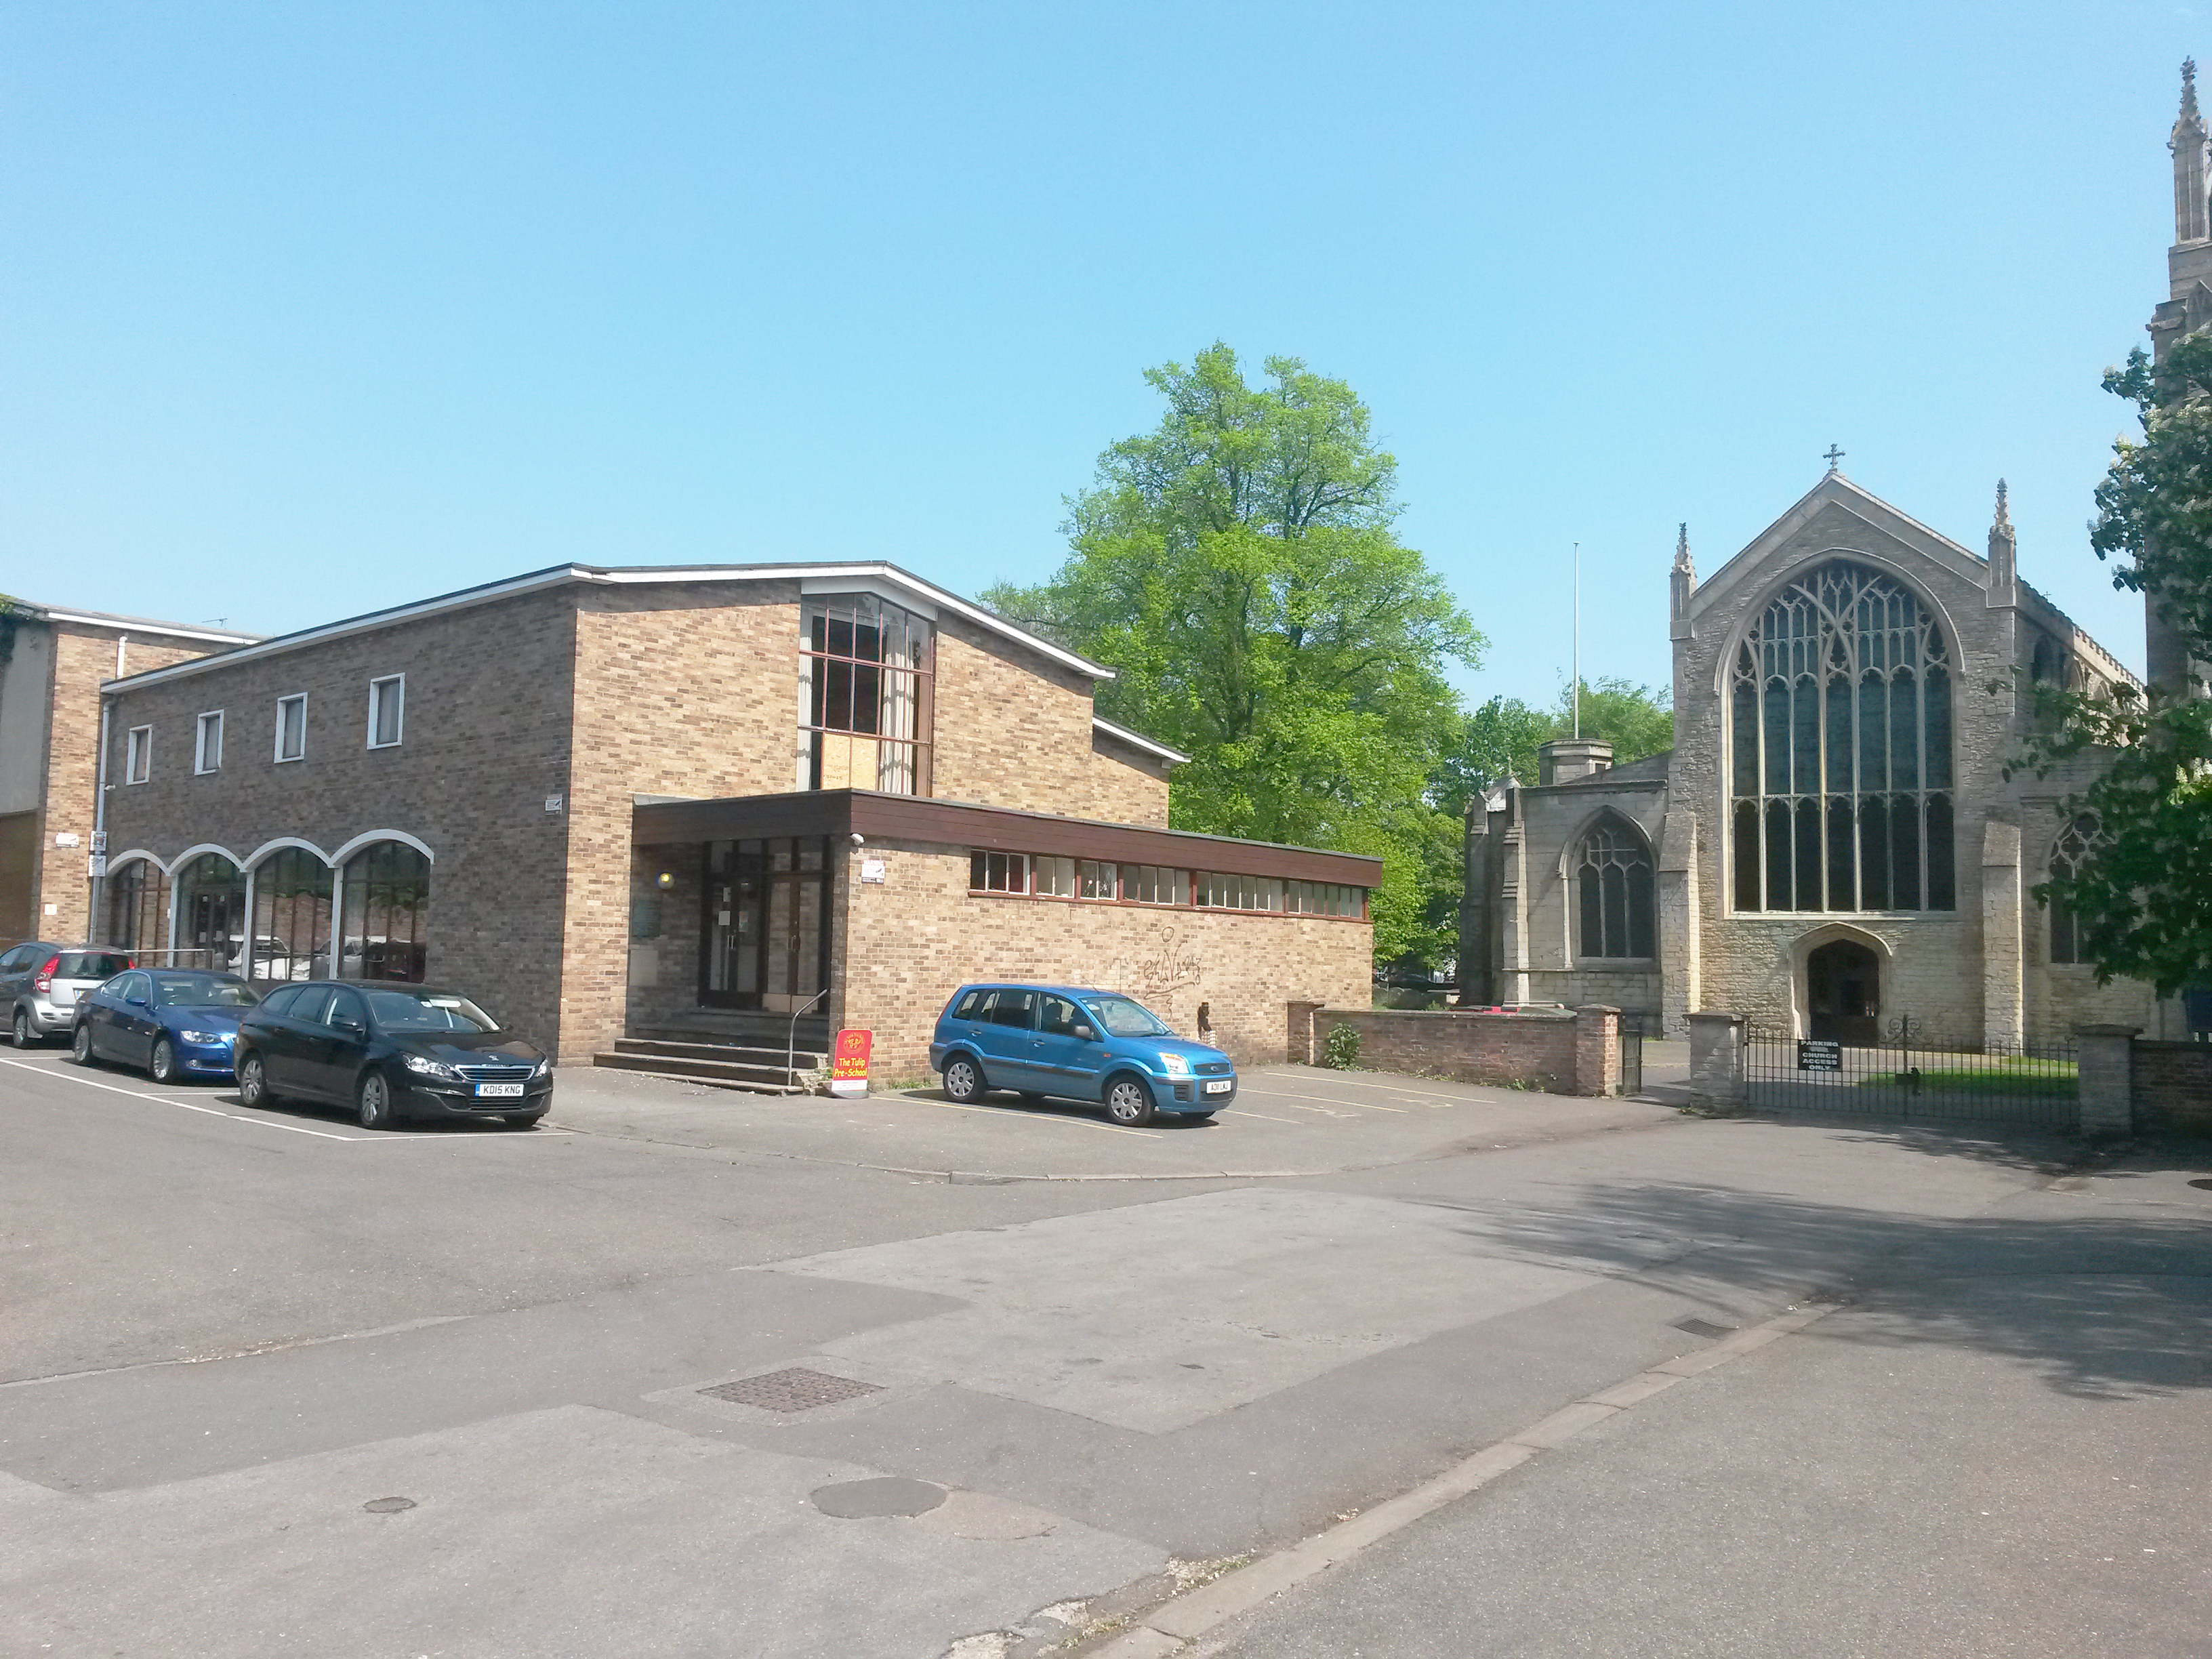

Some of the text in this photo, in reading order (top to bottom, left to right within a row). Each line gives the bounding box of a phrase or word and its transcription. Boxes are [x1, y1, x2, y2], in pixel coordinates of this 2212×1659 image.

[839, 1057, 865, 1068] The Tulip
[834, 1067, 867, 1077] Pre-School
[483, 1085, 520, 1094] KD15 KNG
